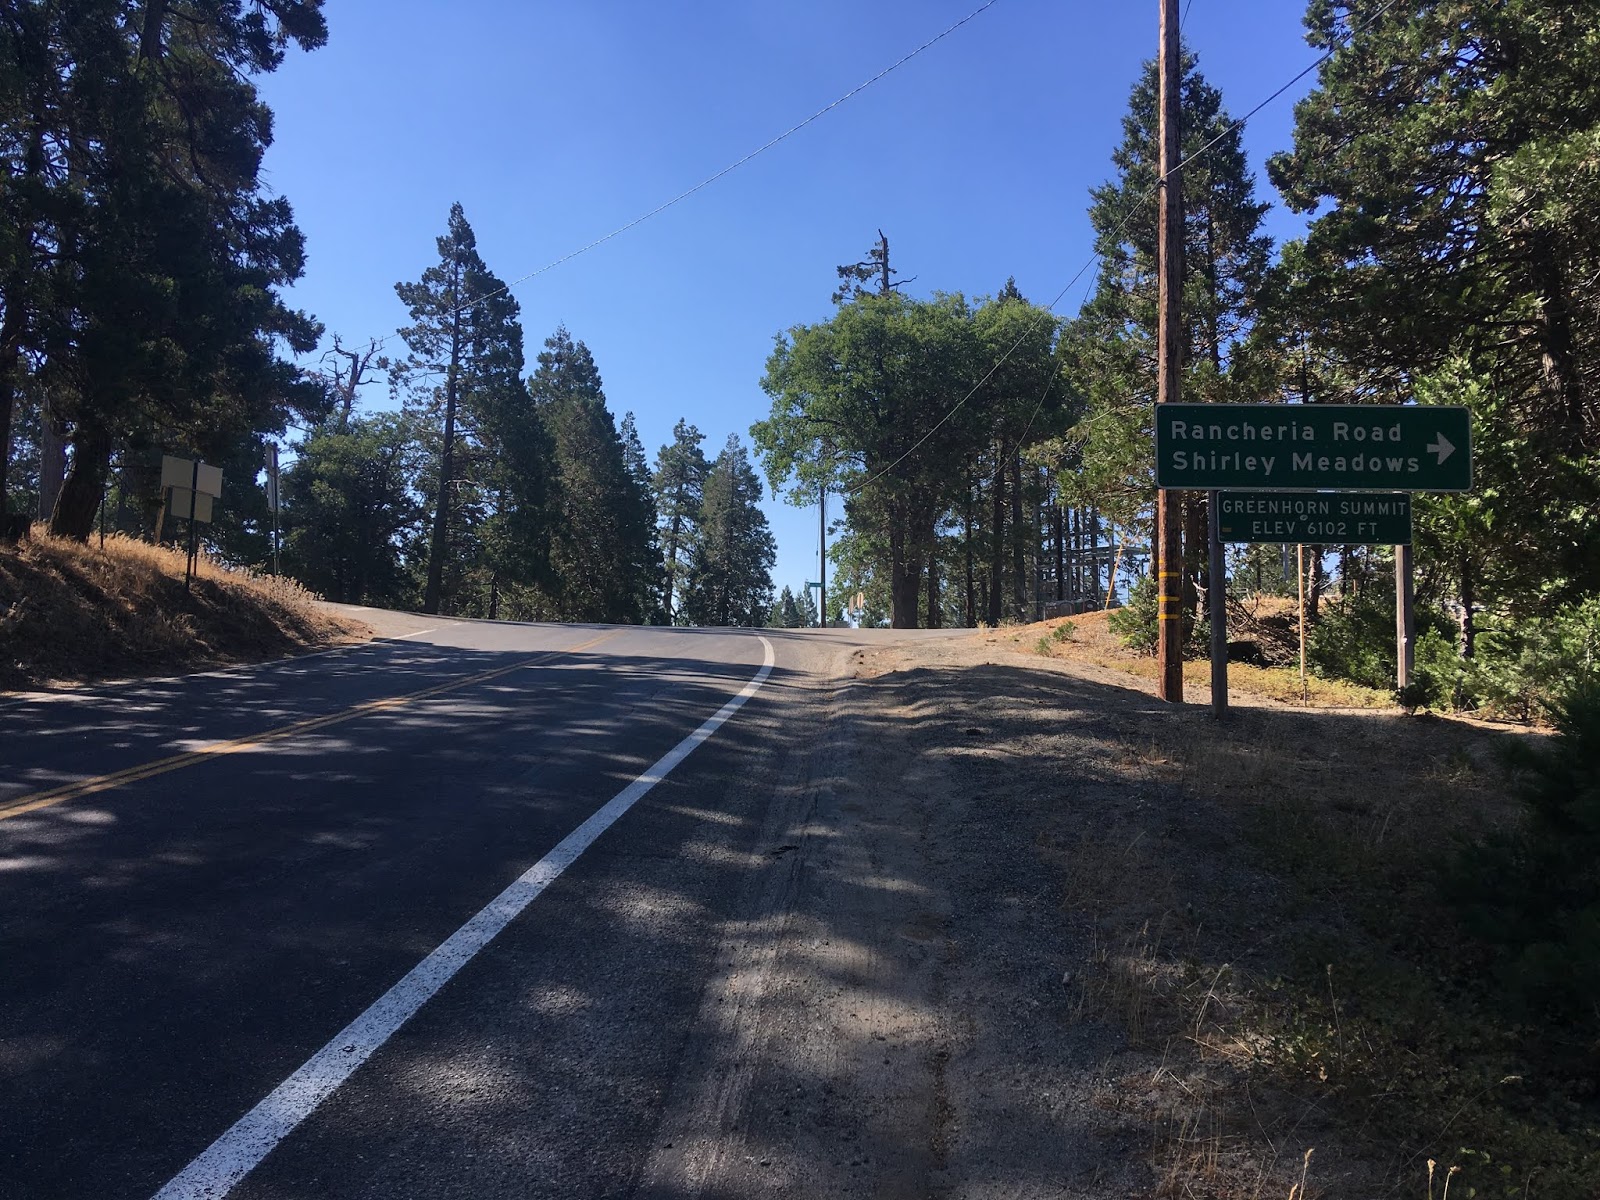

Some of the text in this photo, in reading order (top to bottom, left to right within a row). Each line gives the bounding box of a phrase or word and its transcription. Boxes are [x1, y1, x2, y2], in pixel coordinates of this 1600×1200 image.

[1171, 420, 1402, 442] Rancheria Road
[1172, 450, 1420, 476] Shirley Meadows
[1222, 499, 1407, 516] GREENHORN SUMMIT
[1252, 521, 1378, 536] ELEV 6102 FT
